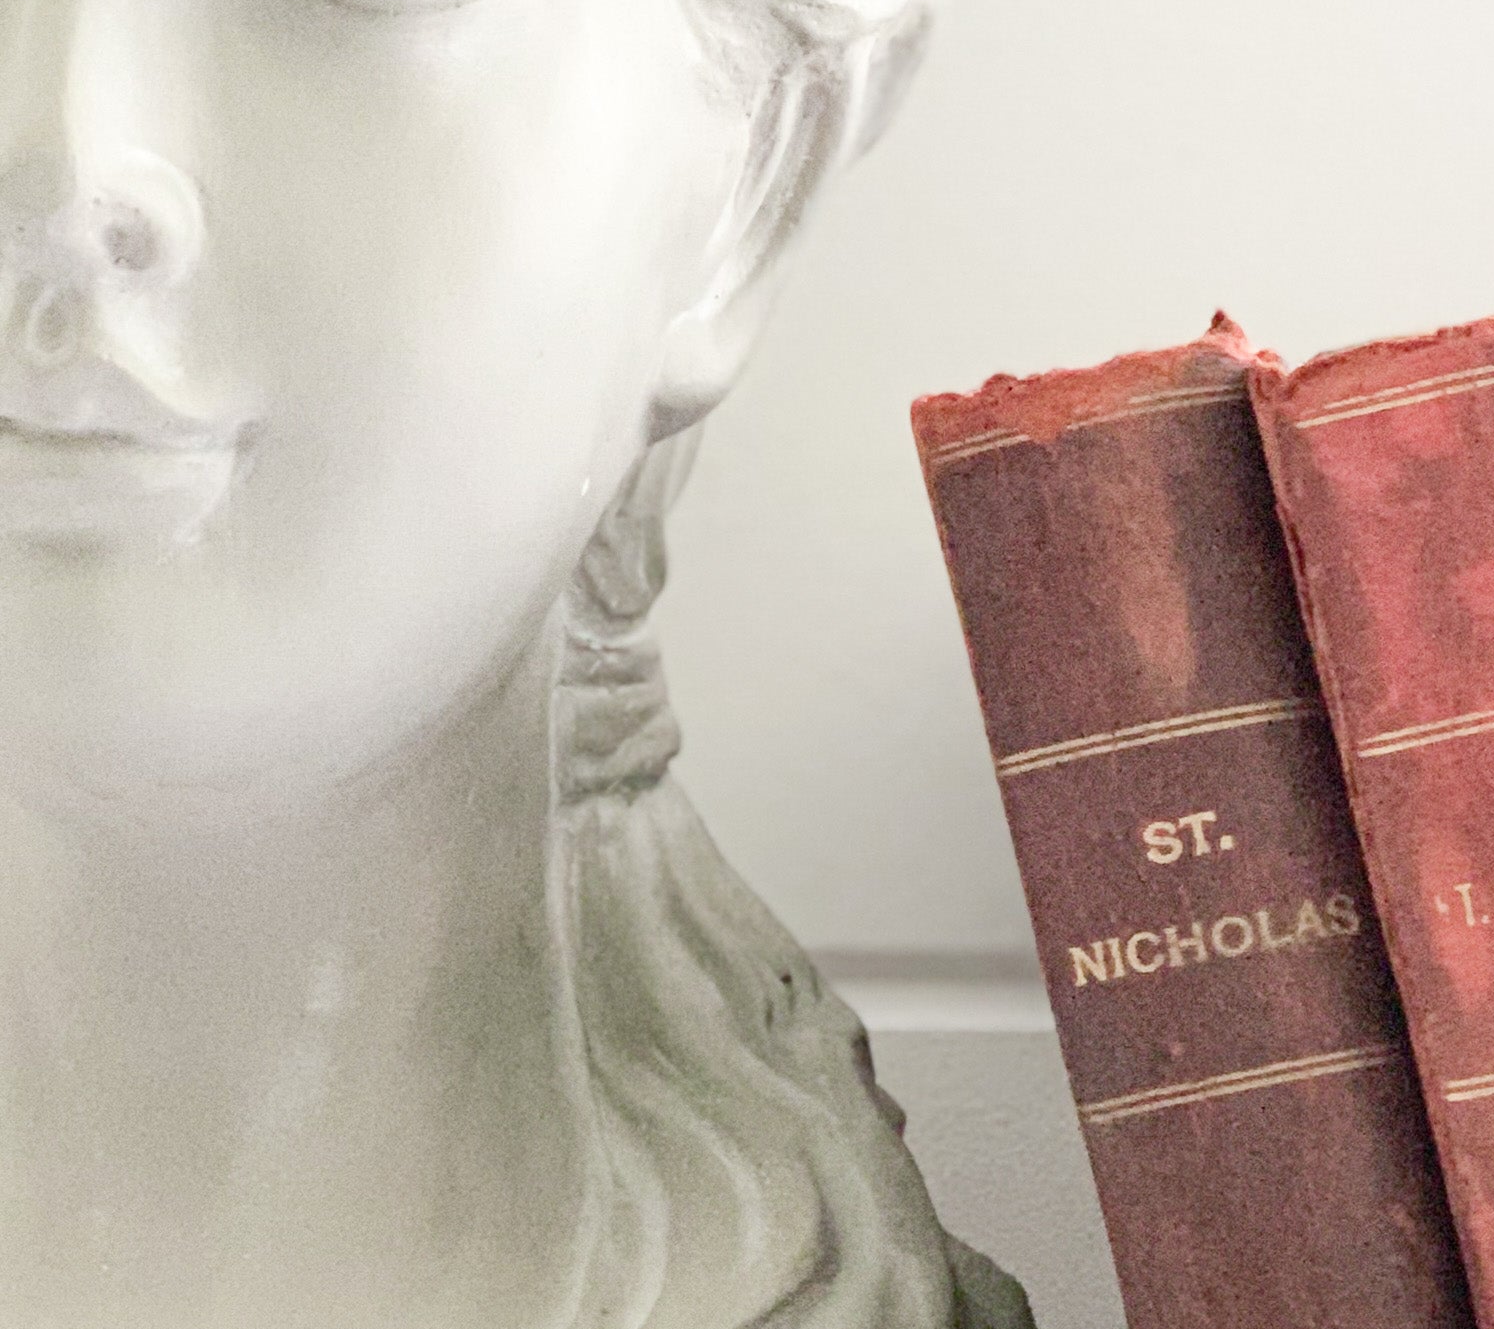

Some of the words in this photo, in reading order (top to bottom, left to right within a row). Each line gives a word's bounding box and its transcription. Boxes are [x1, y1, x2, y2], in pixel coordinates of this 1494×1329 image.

[1141, 809, 1235, 866] ST.
[1434, 881, 1490, 928] T.
[1068, 893, 1363, 988] NICHOLAS
